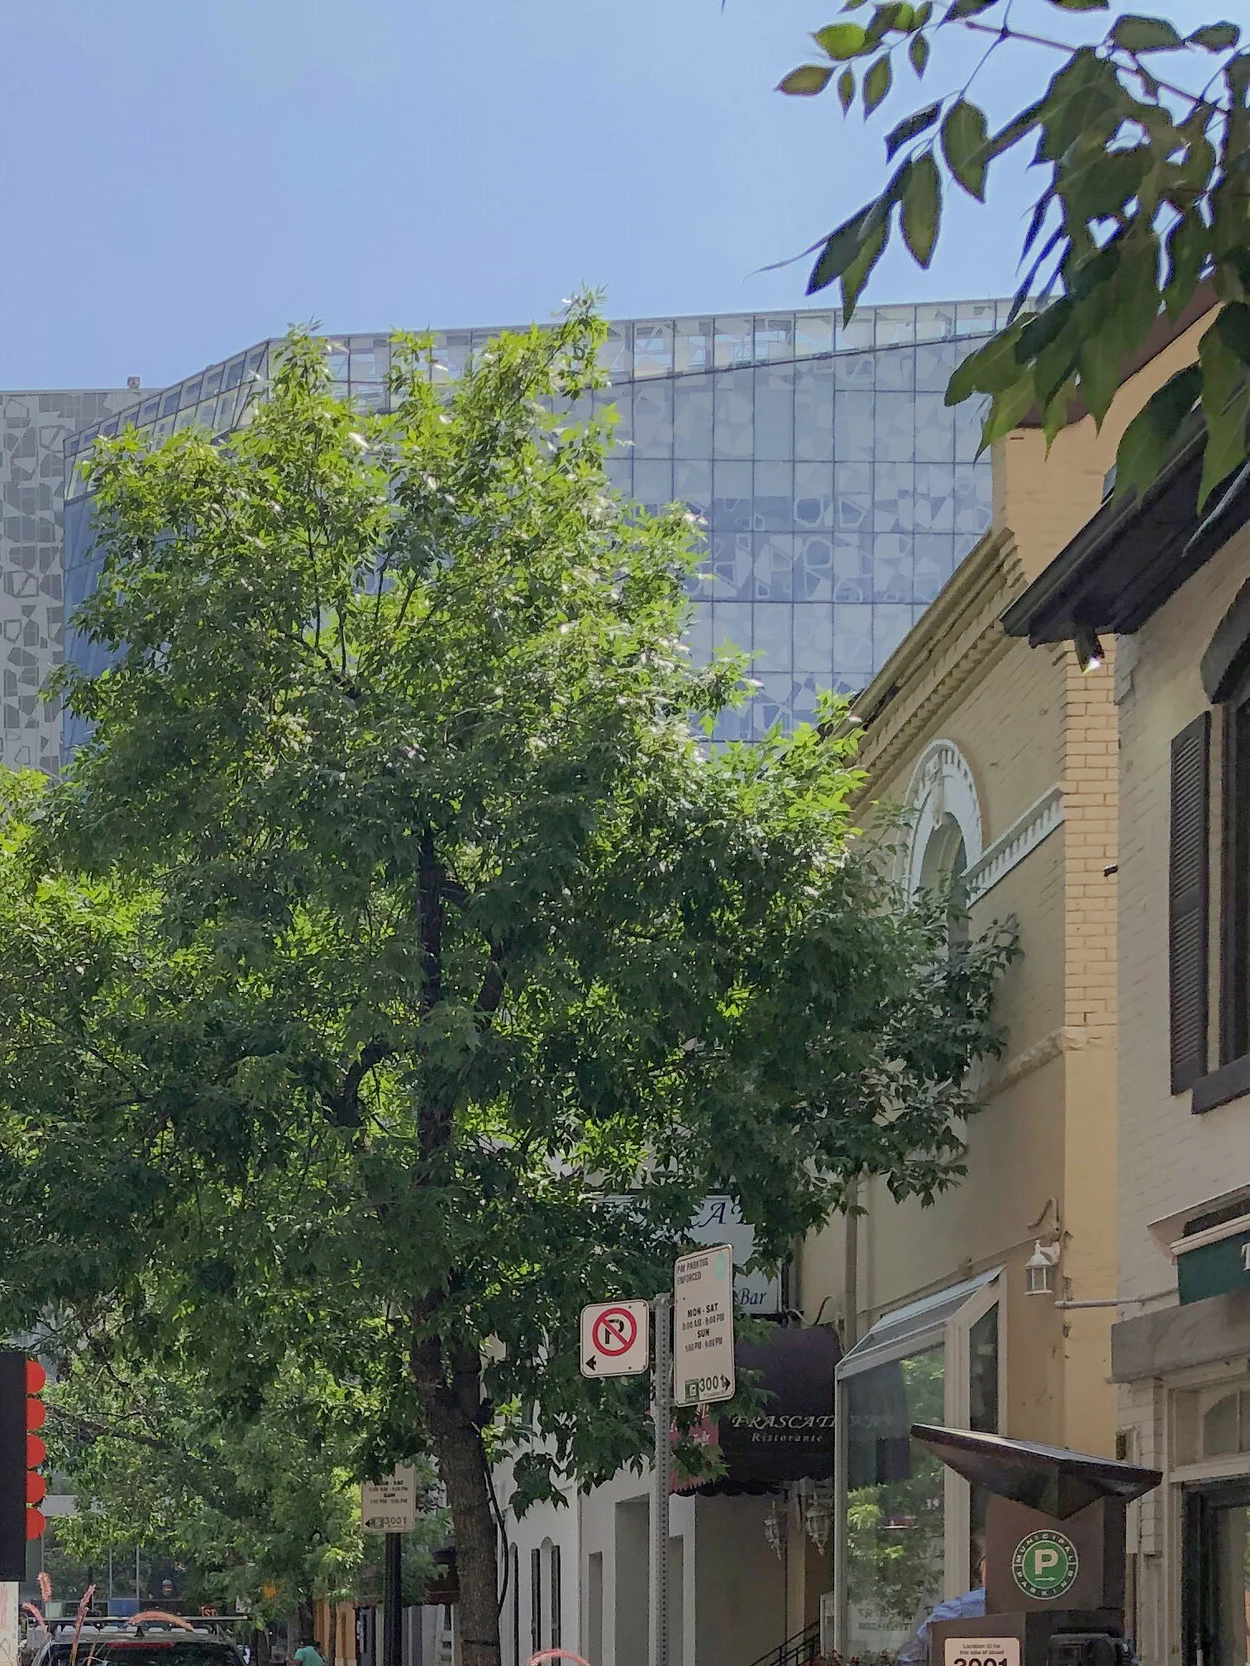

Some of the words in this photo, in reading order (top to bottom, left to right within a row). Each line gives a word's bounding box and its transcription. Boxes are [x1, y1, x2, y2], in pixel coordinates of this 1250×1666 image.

[739, 1287, 767, 1306] Bar
[687, 1307, 701, 1317] MON
[706, 1302, 719, 1313] SAT
[697, 1328, 710, 1338] SUN
[751, 1431, 823, 1443] Ristorante
[1015, 1533, 1074, 1563] MUNICIPAL
[1034, 1548, 1059, 1575] P
